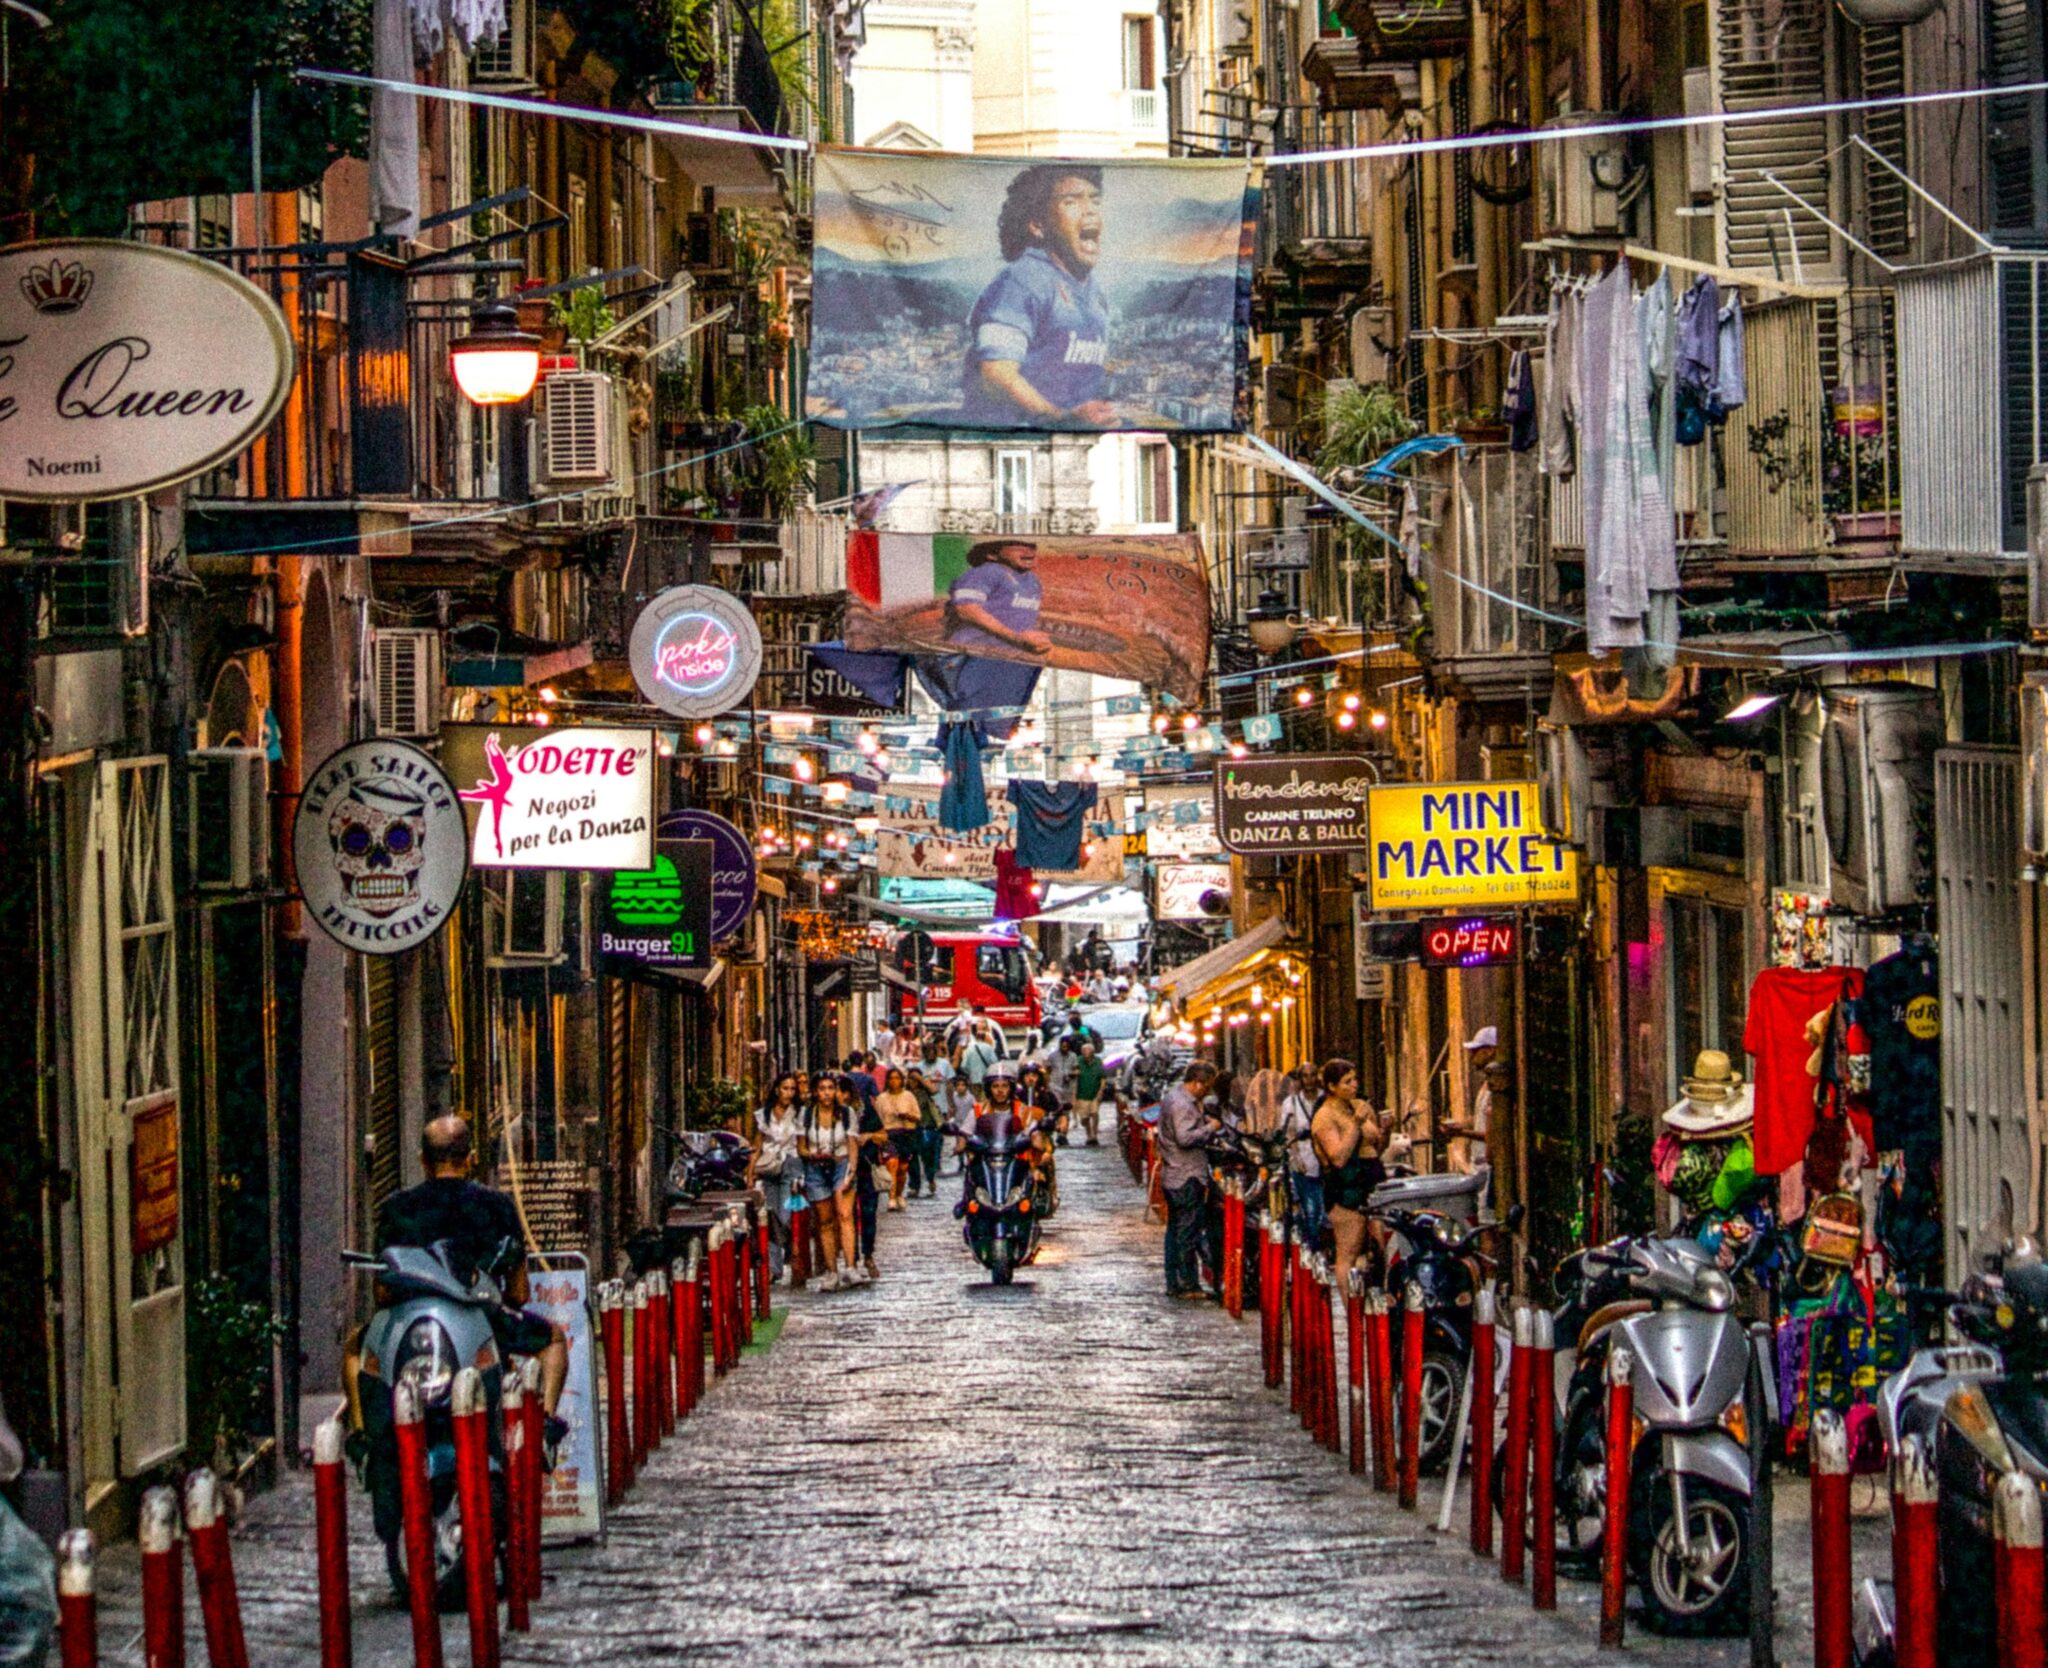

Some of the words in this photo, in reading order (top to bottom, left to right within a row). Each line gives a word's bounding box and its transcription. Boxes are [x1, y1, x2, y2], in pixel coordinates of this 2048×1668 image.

[57, 336, 253, 419] Queen
[27, 455, 102, 477] Noemi
[654, 620, 738, 681] poke
[671, 658, 725, 680] inside
[305, 760, 360, 815] DEAD
[371, 755, 451, 815] SAILOR
[527, 789, 597, 819] Negozi
[1245, 809, 1300, 822] CARMINE
[1302, 807, 1356, 821] TRIUNFO
[1421, 789, 1522, 832] MINI
[510, 832, 541, 857] per
[547, 825, 573, 845] la
[577, 816, 647, 841] Danza
[1230, 826, 1293, 843] DANZA
[1297, 825, 1311, 841] &
[322, 900, 443, 941] TATTOOING
[601, 932, 695, 957] Burger91
[1431, 929, 1511, 954] OPEN
[934, 986, 953, 998] 115
